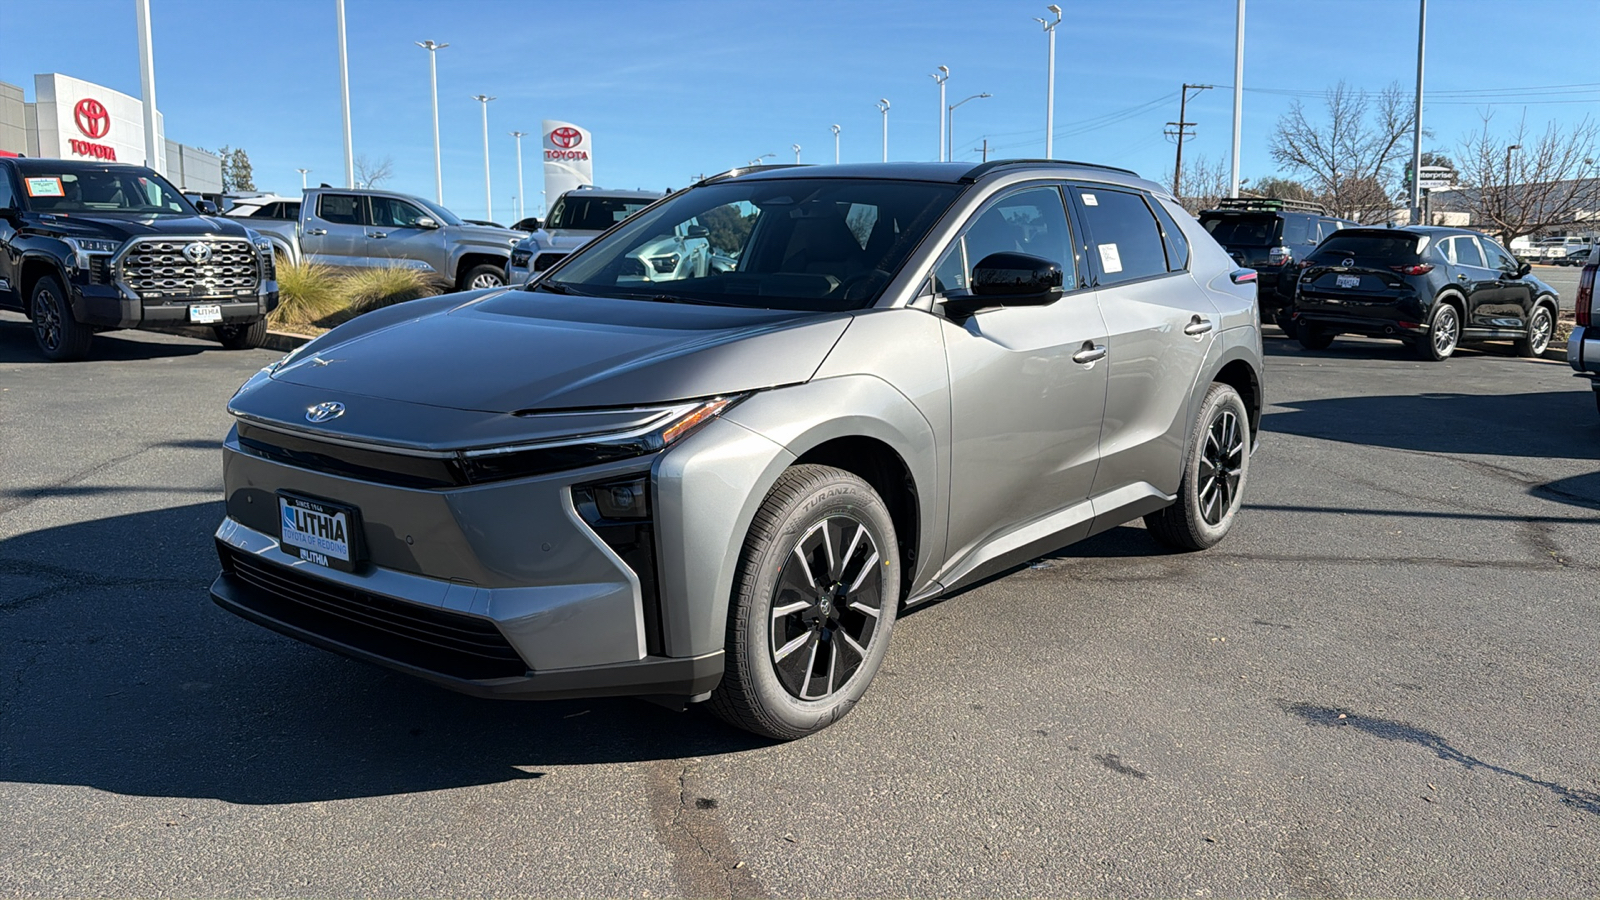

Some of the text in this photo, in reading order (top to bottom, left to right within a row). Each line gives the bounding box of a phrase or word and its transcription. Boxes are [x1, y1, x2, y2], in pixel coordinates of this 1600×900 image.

[68, 138, 117, 162] TOYOTA
[545, 150, 588, 160] TOYOTA
[198, 308, 220, 316] LITHIA
[295, 500, 311, 510] SINCE
[802, 487, 857, 513] TURANZA
[295, 509, 346, 543] LITHIA
[283, 528, 347, 555] TOYOTA OF REDDING
[306, 550, 329, 566] LITHIA
